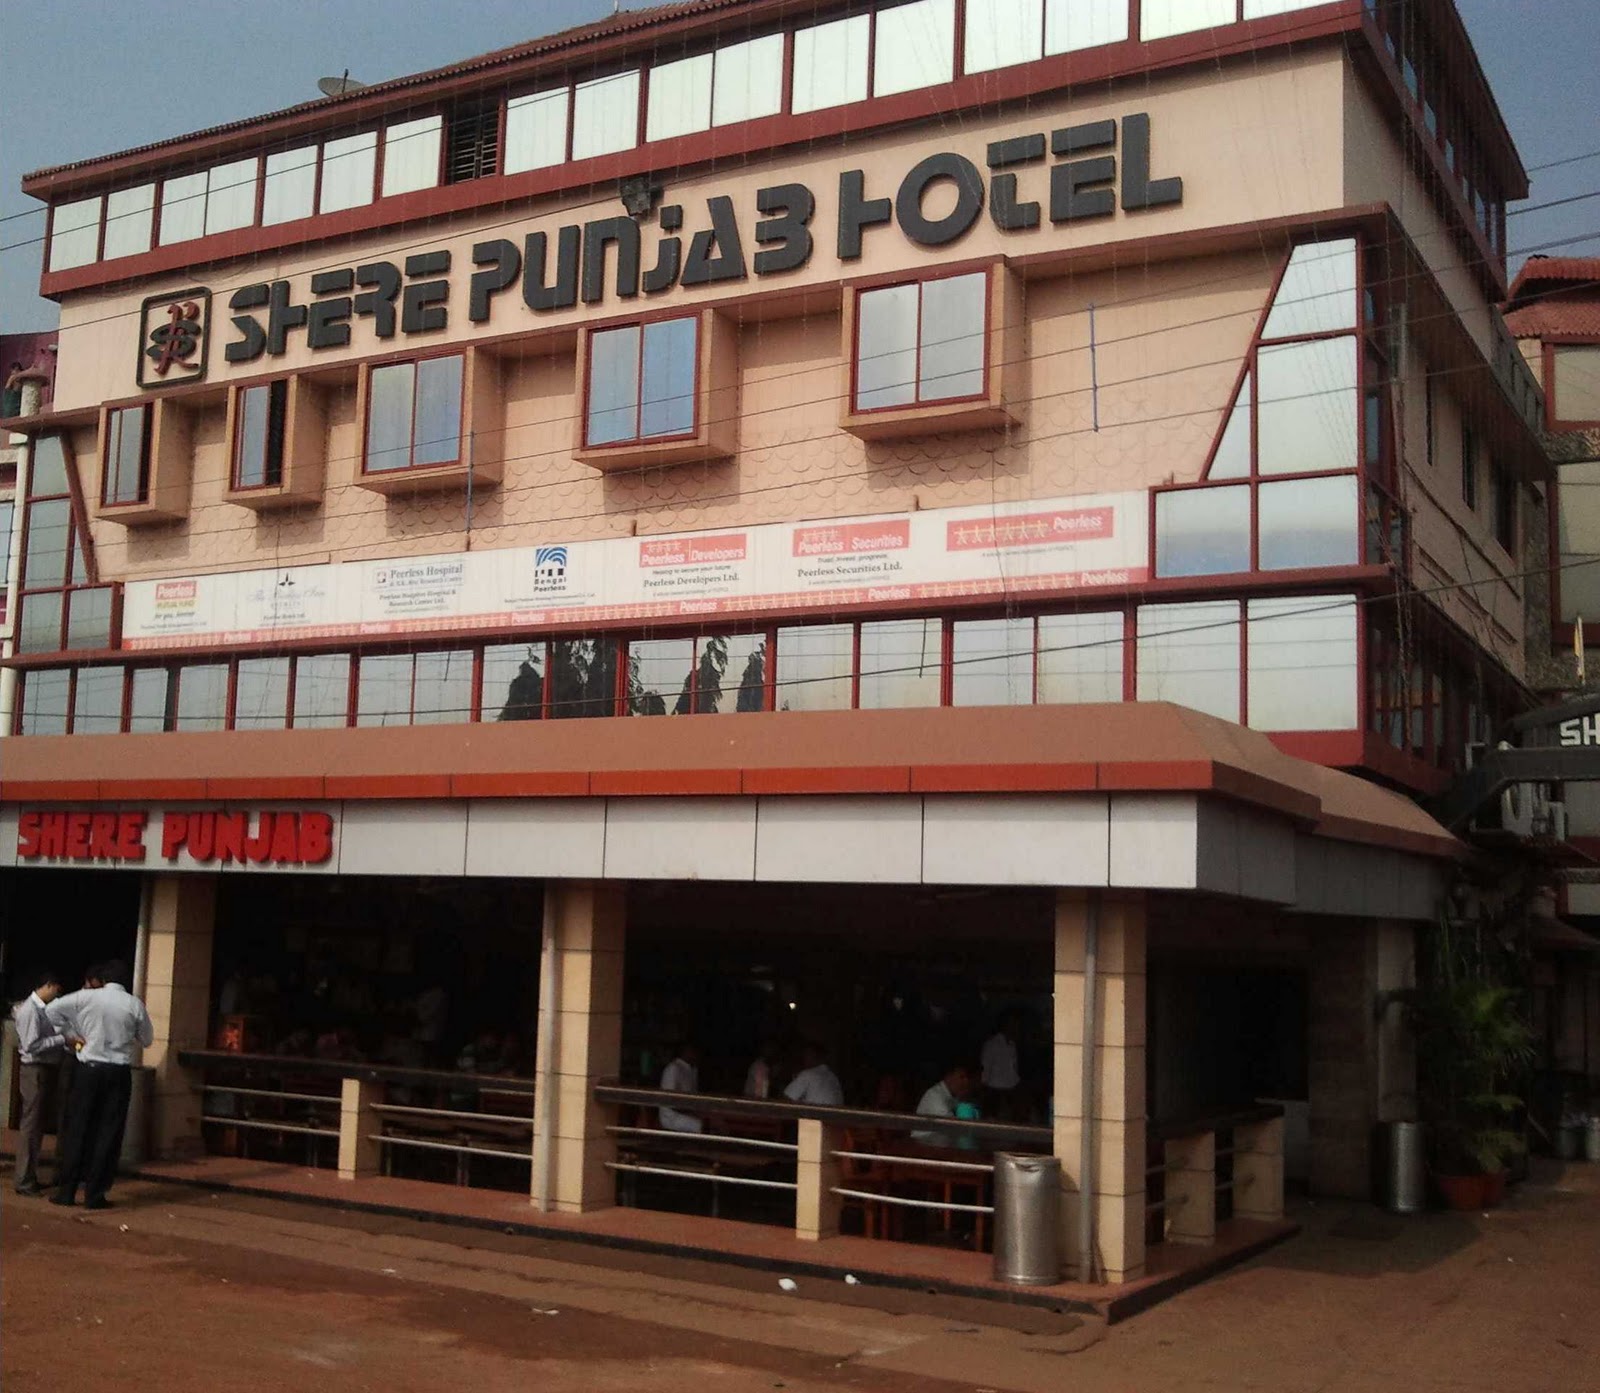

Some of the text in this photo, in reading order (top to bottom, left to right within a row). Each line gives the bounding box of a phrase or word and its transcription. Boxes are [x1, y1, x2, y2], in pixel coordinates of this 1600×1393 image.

[225, 250, 450, 362] SHERE
[837, 112, 1183, 260] HOTEL
[1053, 514, 1103, 530] Peerless
[798, 533, 904, 554] Peerless Securities
[641, 548, 745, 566] Peerless Developers
[390, 563, 463, 580] Peerless Hospital
[797, 561, 903, 578] Peerless Securities Ltd.
[1081, 569, 1129, 586] Peerless
[534, 577, 566, 585] Bengal
[643, 572, 740, 588] Peerless Developers Ltd.
[533, 585, 566, 593] Peerless
[868, 587, 911, 602] Peerless
[681, 599, 717, 614] Peerless
[17, 810, 335, 864] SHERE PUNJAB
